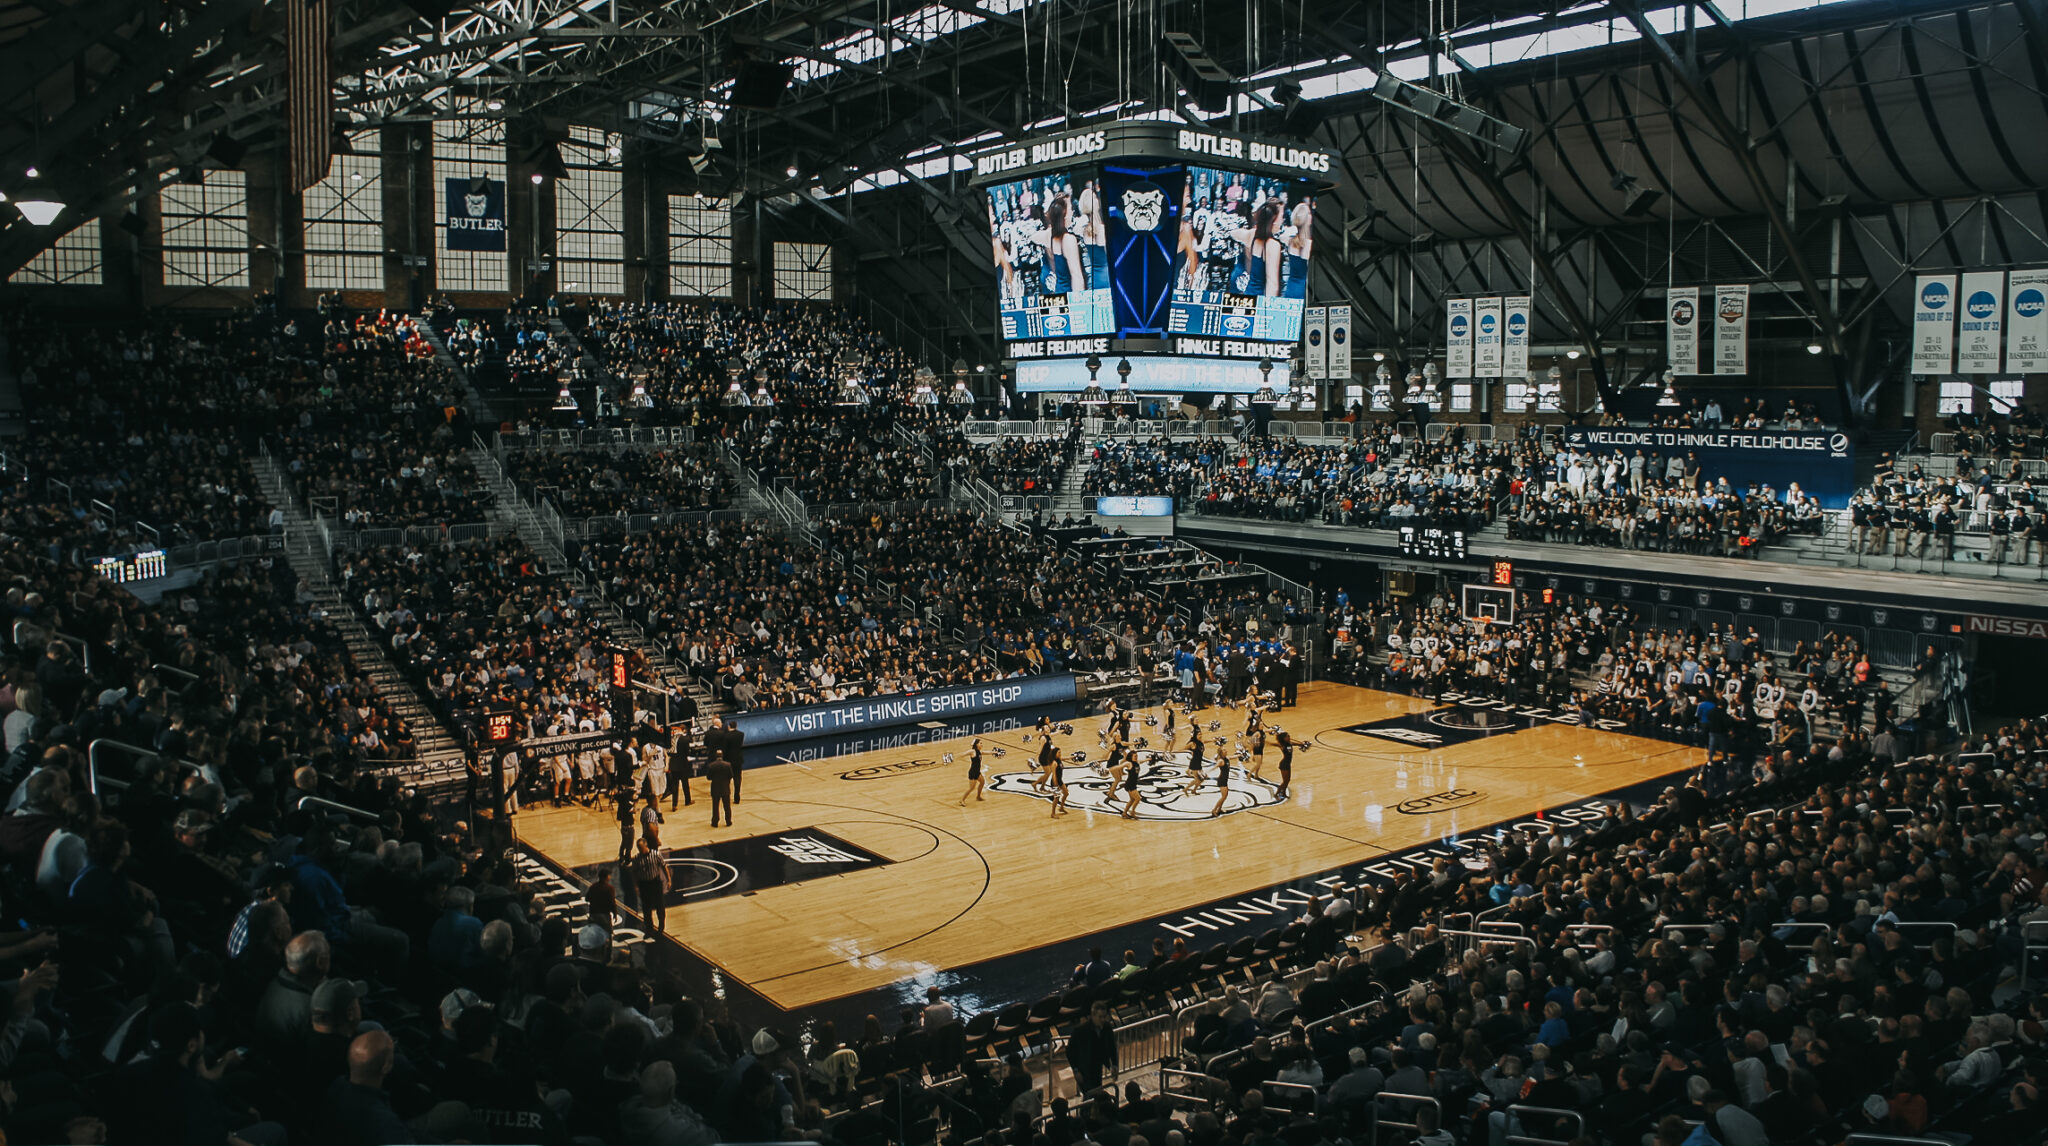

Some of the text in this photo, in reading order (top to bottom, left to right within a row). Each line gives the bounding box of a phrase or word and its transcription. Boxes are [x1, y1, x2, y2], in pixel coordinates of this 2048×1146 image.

[978, 131, 1105, 175] BUTLER BULLDOGS
[1179, 130, 1329, 173] BUTLER BULLDOGS
[450, 217, 504, 231] BUTLER
[1209, 291, 1218, 303] 17
[1230, 296, 1254, 308] 11:54
[1969, 303, 1997, 312] NCAA
[1010, 338, 1108, 358] HINKLE FIELDHOUSE
[1177, 338, 1291, 359] HINKLE FIELDHOUSE
[1018, 366, 1049, 384] SHOP
[1588, 432, 1652, 445] WELCOME
[1656, 433, 1675, 446] TO
[1678, 434, 1728, 447] HINKLE
[1731, 435, 1825, 450] FIELDHOUSE
[1495, 570, 1511, 585] 30
[785, 686, 1022, 732] VISIT THE HINKLE SPIRIT SHOP
[492, 726, 508, 739] 30
[581, 740, 610, 750] pnc.com
[1159, 875, 1360, 937] HINKLE
